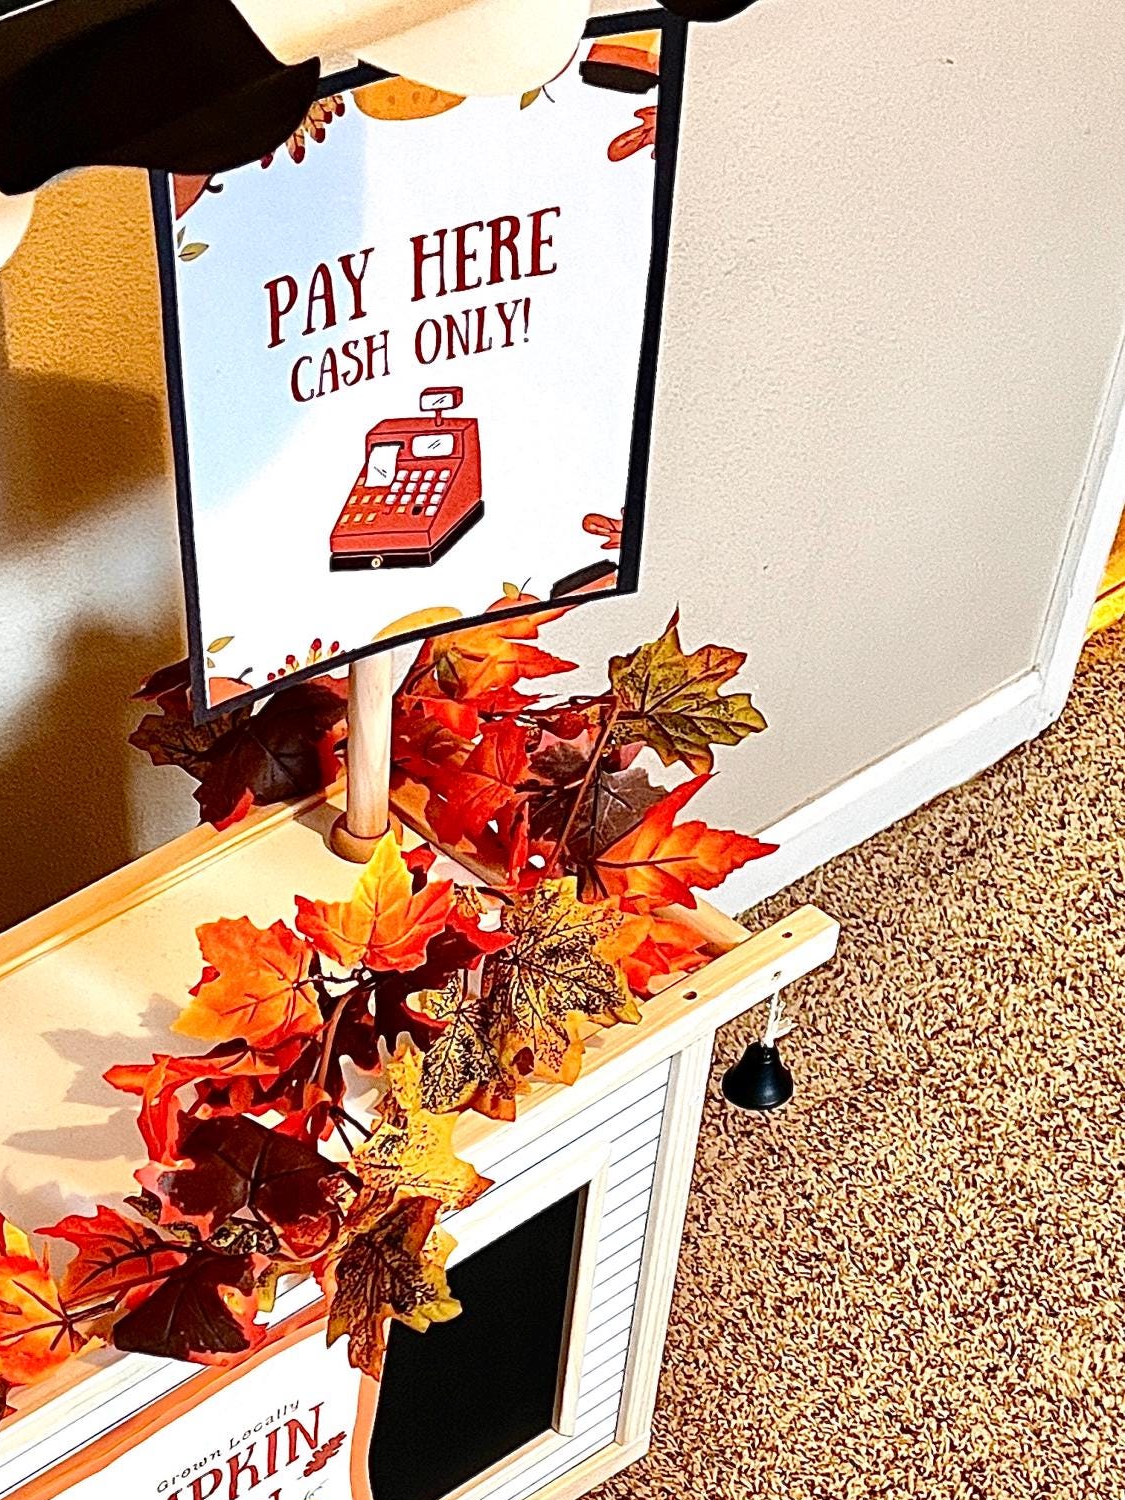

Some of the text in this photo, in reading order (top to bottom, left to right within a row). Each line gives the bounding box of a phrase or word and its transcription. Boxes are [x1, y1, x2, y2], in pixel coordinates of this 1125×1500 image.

[264, 206, 562, 349] PAY HERE
[290, 297, 532, 402] CASH ONLY!
[157, 1400, 299, 1493] Grown Locally
